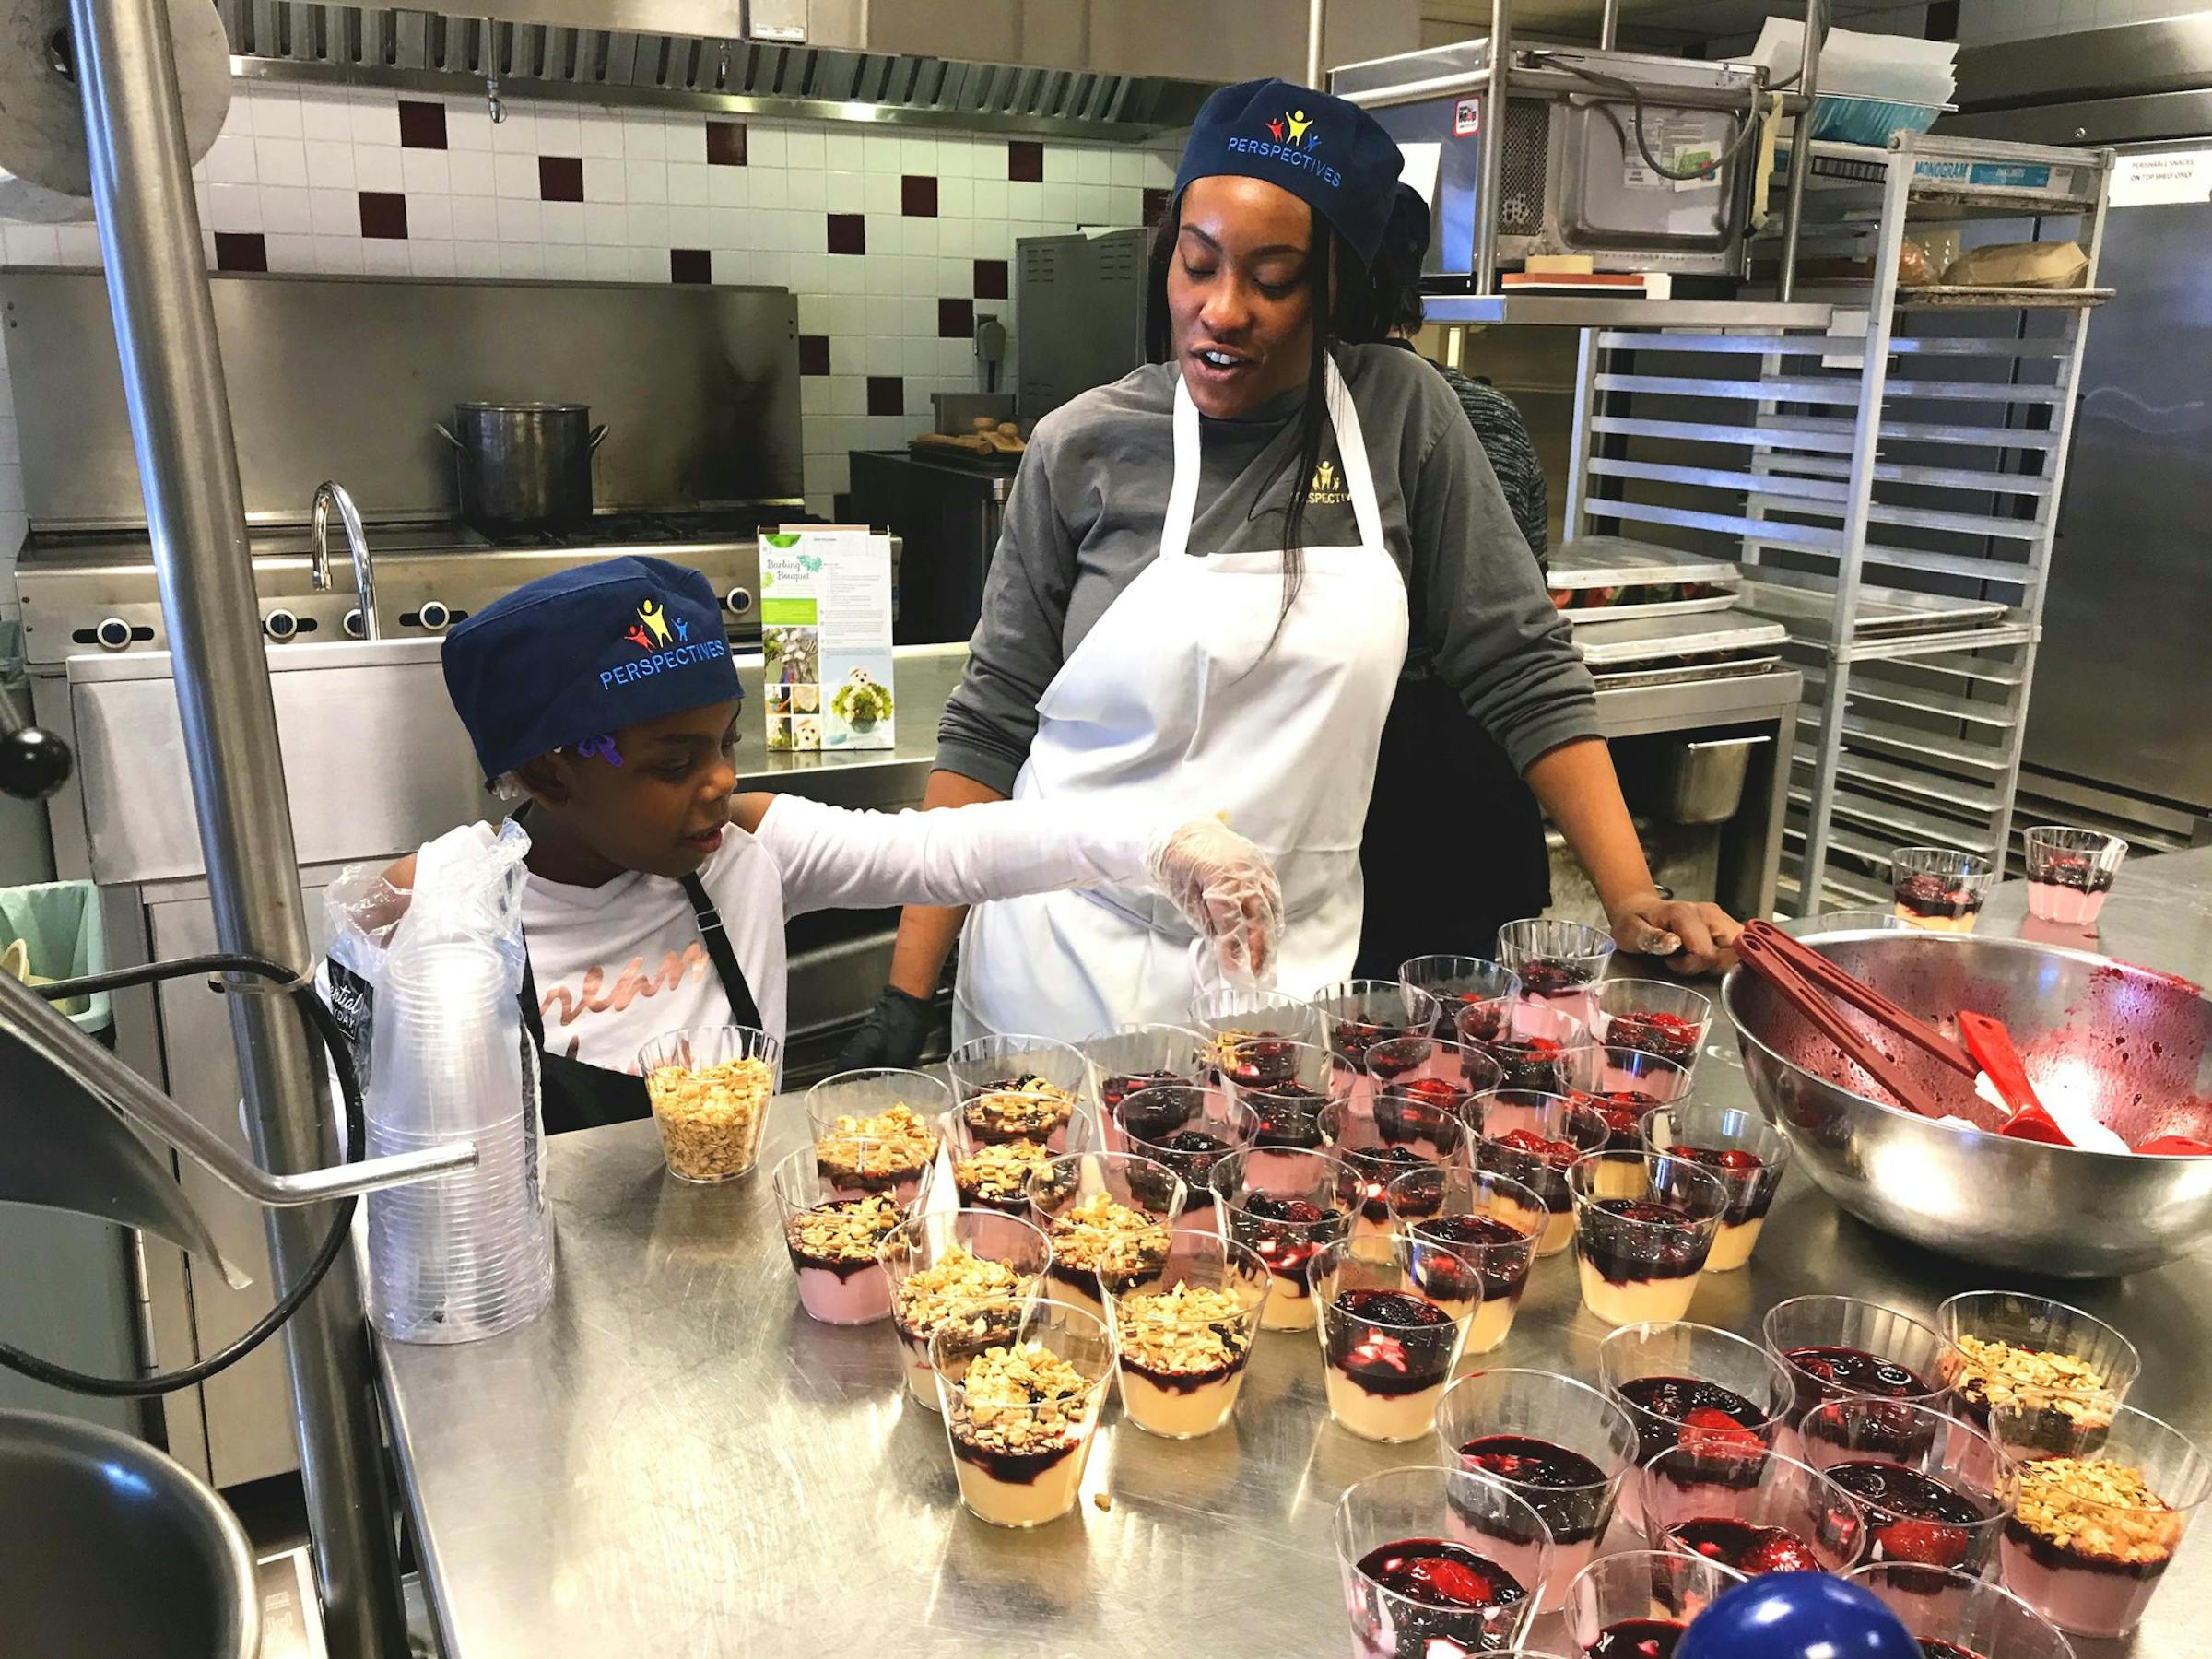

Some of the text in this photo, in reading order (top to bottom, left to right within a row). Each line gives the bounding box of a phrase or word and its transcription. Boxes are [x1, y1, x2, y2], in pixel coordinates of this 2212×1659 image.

[1228, 137, 1342, 188] PERSPECTIVES
[1914, 161, 1969, 179] MONOGRAM
[767, 559, 801, 572] Barking
[777, 571, 810, 582] Bouquet
[599, 639, 725, 690] PERSPECTIVES
[330, 985, 364, 1015] ential
